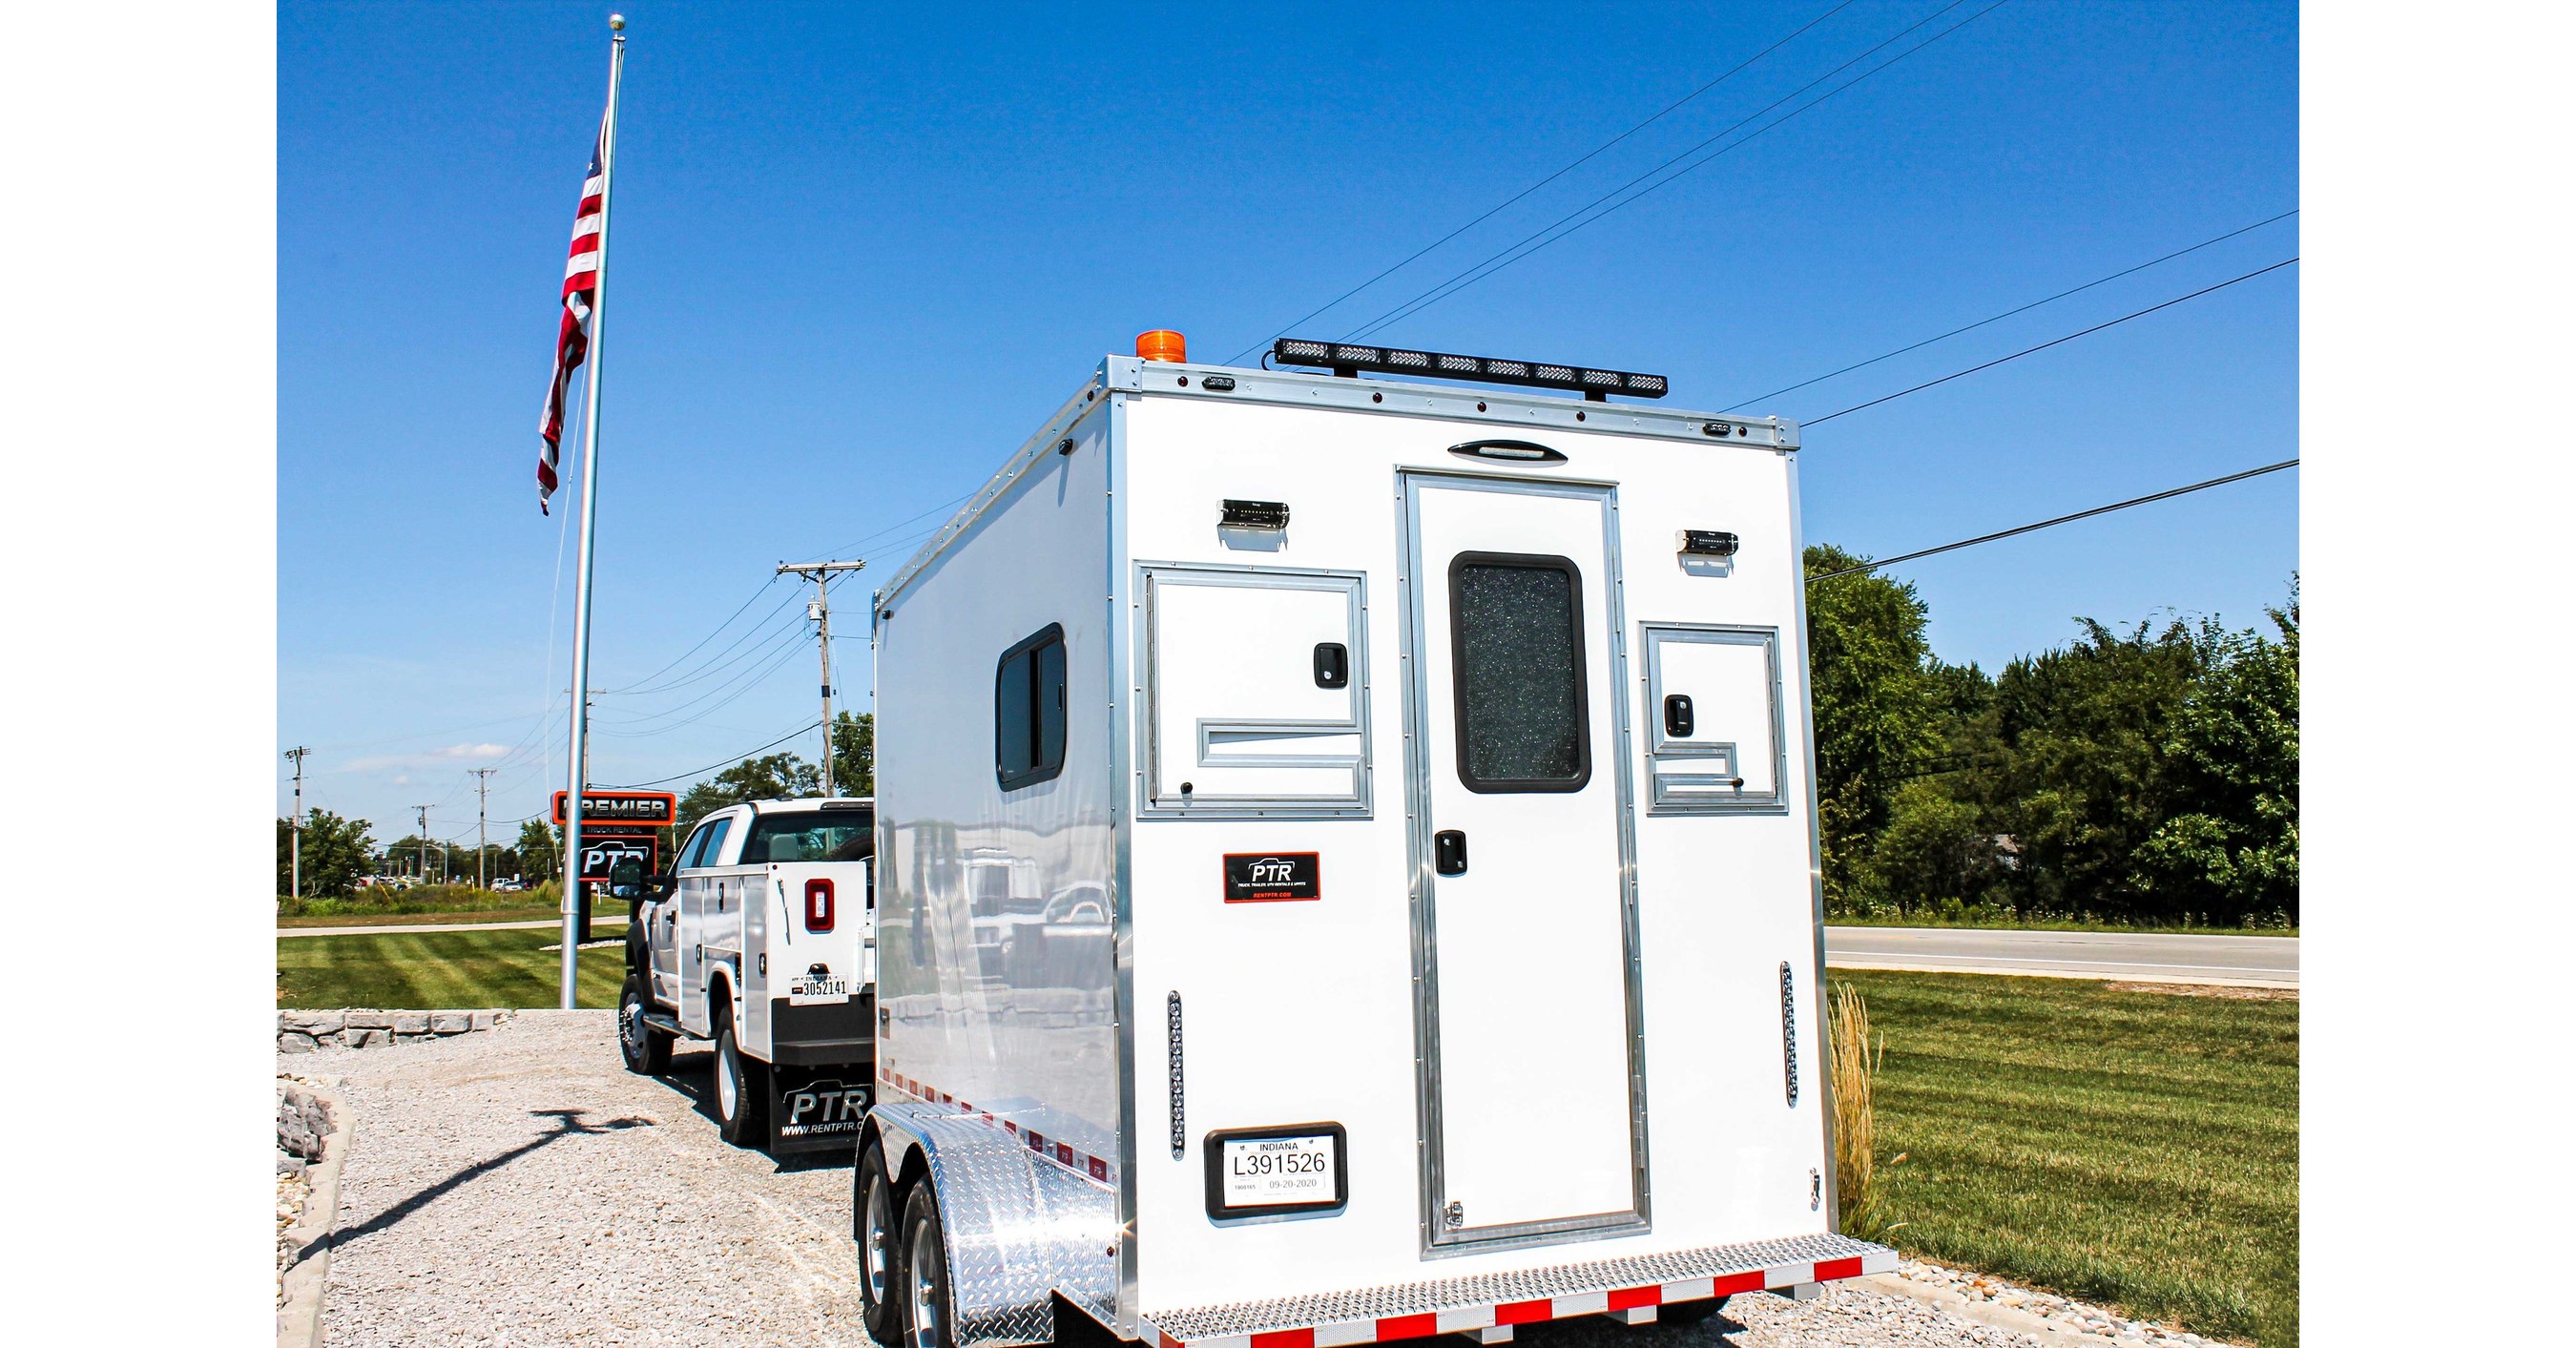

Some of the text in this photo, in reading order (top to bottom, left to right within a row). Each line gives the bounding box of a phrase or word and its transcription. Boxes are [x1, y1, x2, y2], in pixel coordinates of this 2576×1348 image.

[562, 799, 667, 818] REMIER
[1252, 864, 1292, 881] PTR
[803, 981, 846, 996] 3052141
[790, 1089, 867, 1125] PTR
[1259, 1142, 1298, 1151] INDIANA
[1234, 1151, 1325, 1175] L391526
[1269, 1178, 1318, 1189] 09-20-2020
